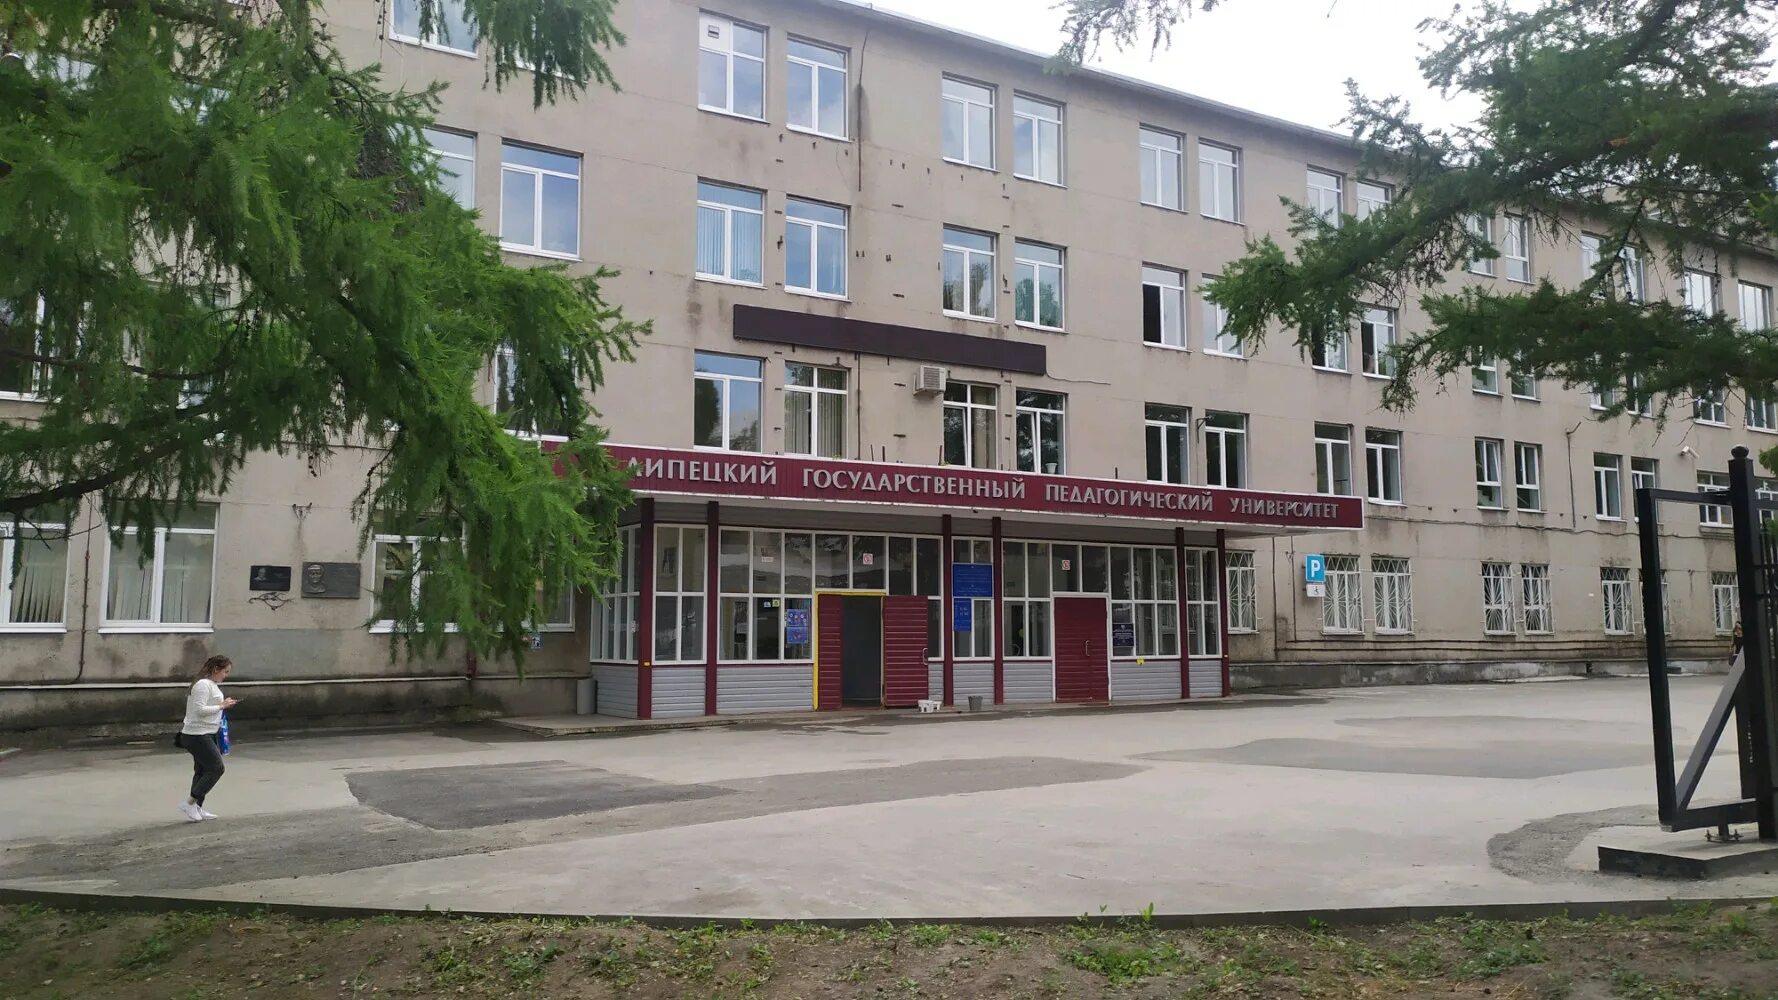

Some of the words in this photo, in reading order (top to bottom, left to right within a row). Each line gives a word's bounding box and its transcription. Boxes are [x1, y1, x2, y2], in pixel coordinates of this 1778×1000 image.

[802, 468, 1025, 499] ГОСУДАРСТВЕННЫЙ
[1045, 484, 1213, 512] ПЕДАГОГИЧЕСКИЙ
[1230, 498, 1339, 519] УНИВЕРСИТЕТ
[1311, 559, 1321, 578] P
